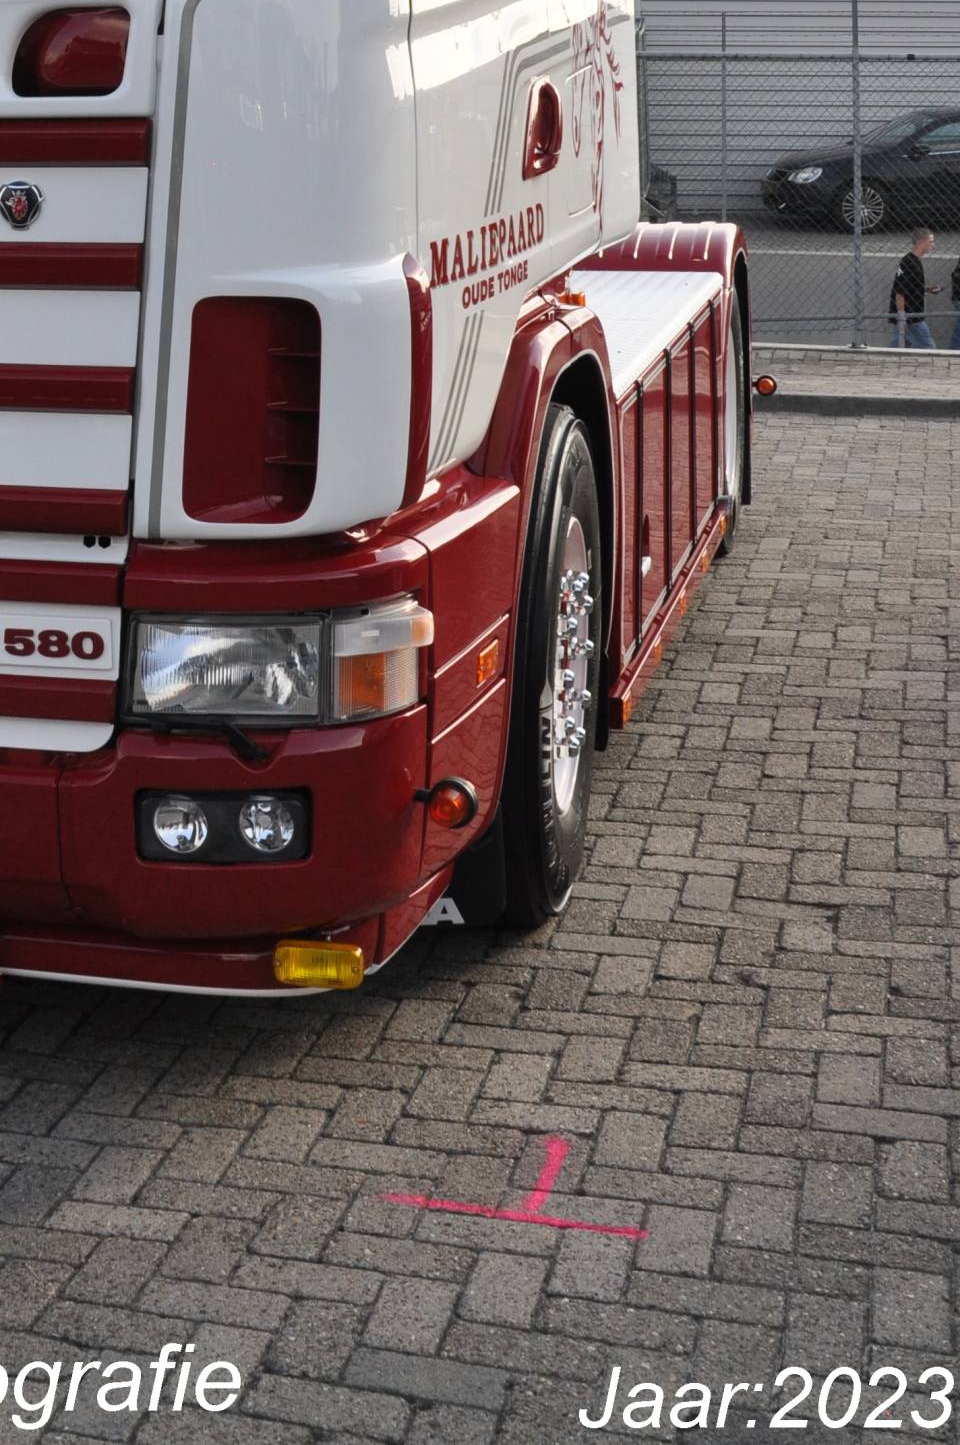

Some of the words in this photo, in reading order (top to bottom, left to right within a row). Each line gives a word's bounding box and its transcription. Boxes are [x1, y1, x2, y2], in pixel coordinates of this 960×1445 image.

[429, 203, 544, 289] MALIEPAARD
[462, 276, 495, 309] OUDE
[497, 260, 529, 295] TONGE
[4, 628, 105, 660] 580
